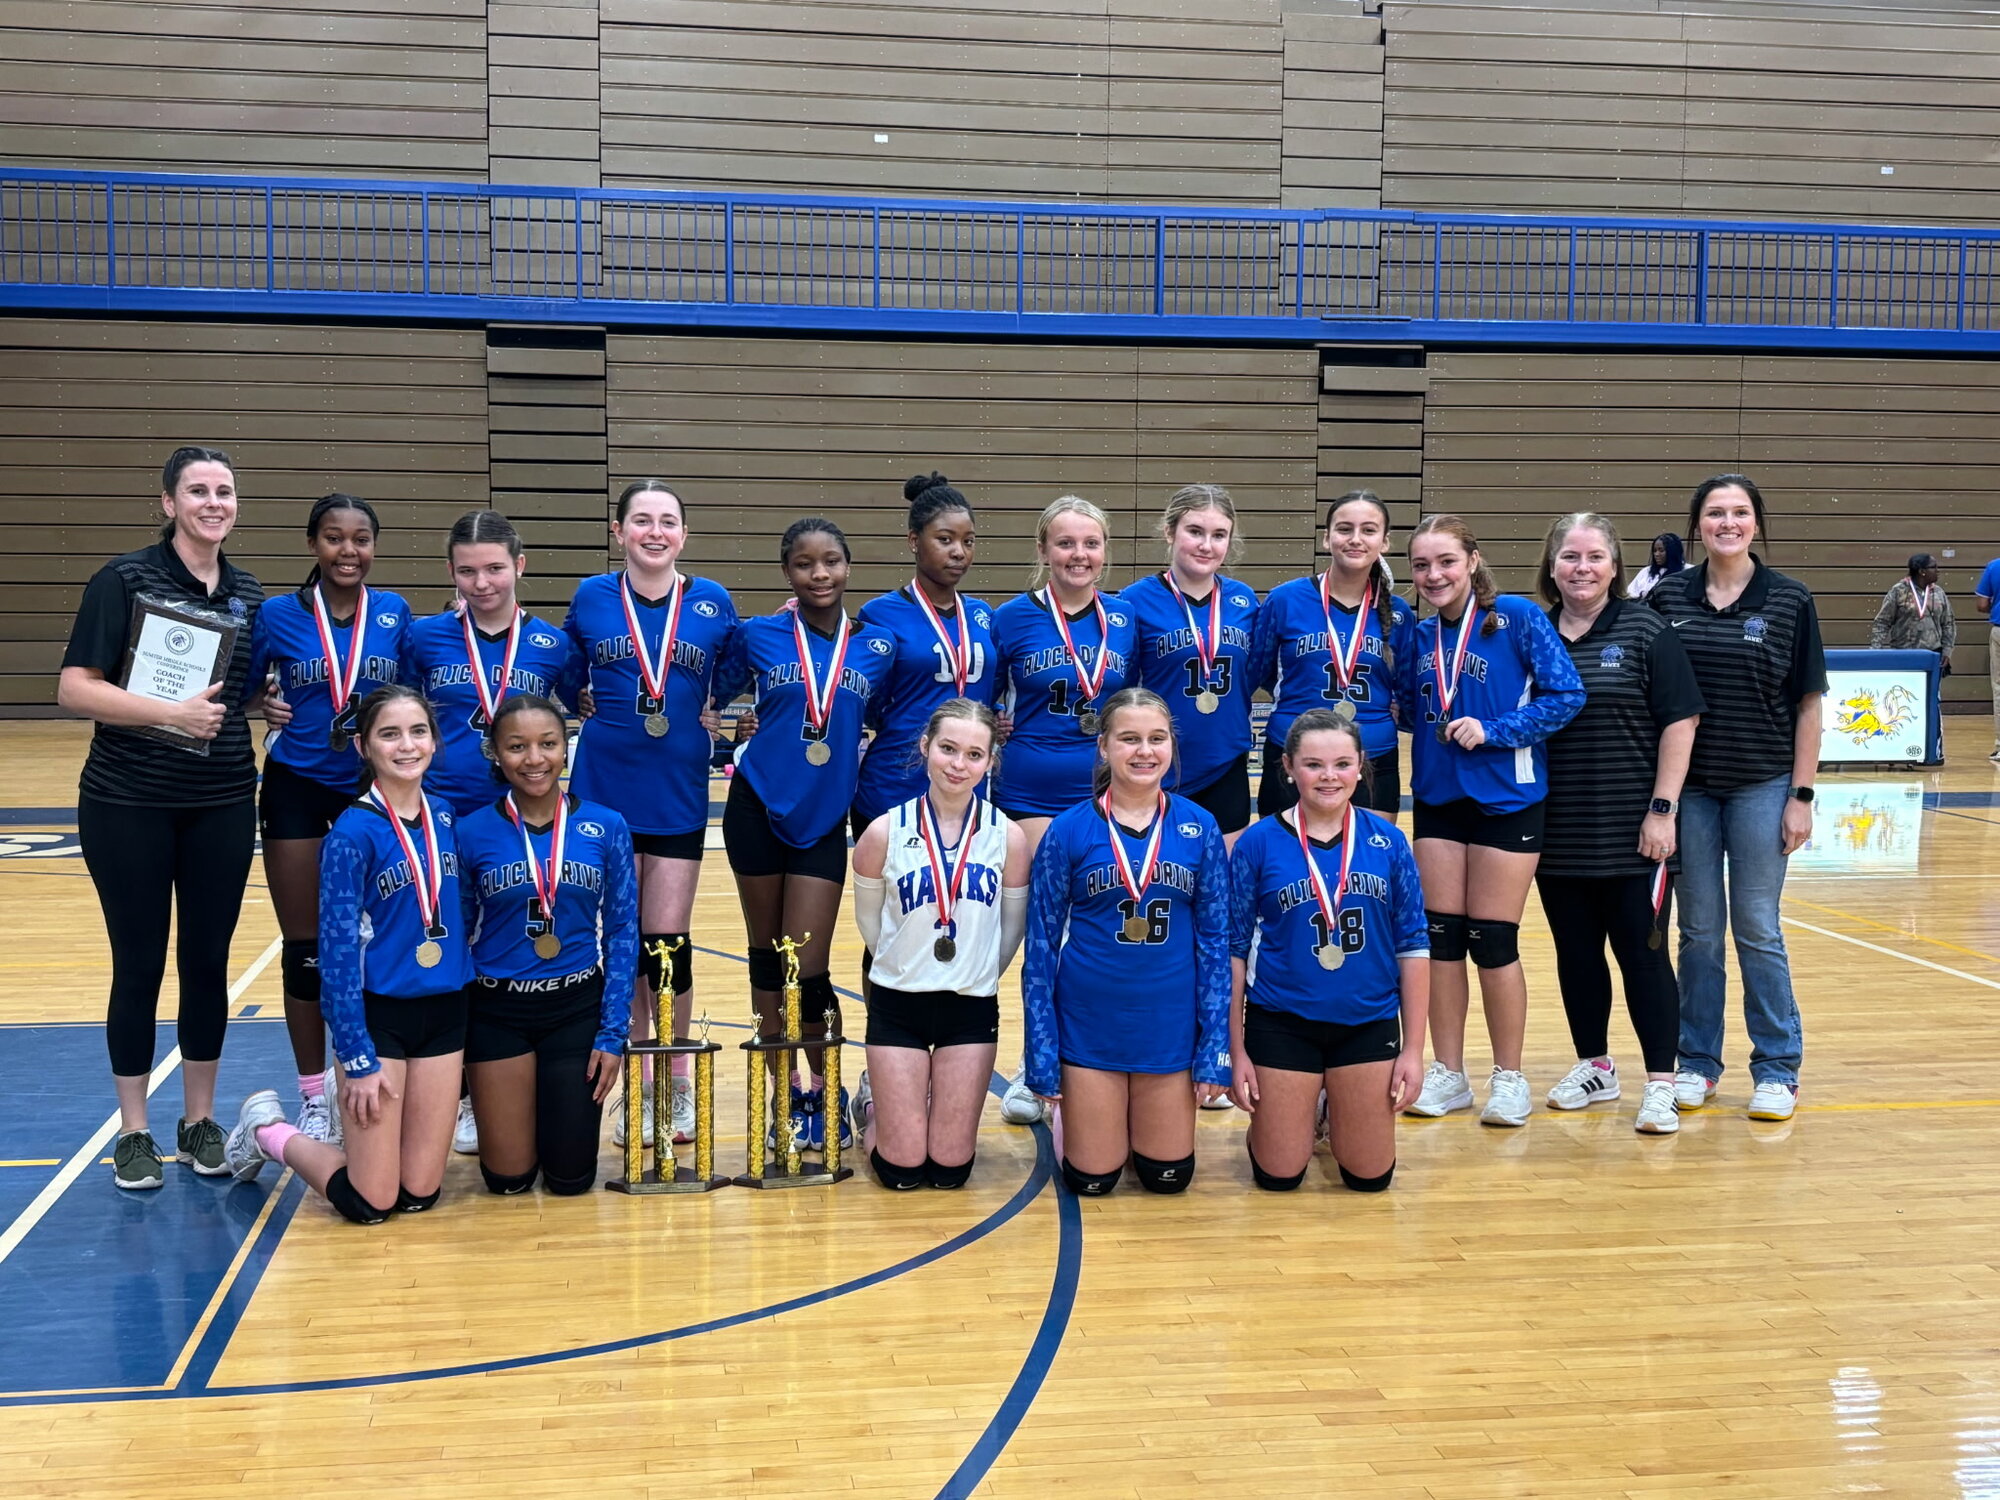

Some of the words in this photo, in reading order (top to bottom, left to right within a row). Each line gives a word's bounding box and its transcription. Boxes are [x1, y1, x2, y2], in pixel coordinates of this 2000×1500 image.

[699, 603, 714, 616] AD
[1111, 614, 1123, 625] AD
[534, 634, 551, 647] AD
[596, 634, 637, 666] ALIC
[873, 641, 888, 653] AD
[1156, 626, 1201, 659] ALIC
[155, 668, 186, 682] COACH
[290, 656, 331, 689] ALIC
[430, 663, 477, 692] ALIC
[932, 641, 985, 684] 10
[1079, 644, 1126, 679] DIVE
[1183, 655, 1233, 698] 13
[152, 676, 166, 684] OF
[166, 679, 185, 690] THE
[156, 684, 179, 696] YEAR
[1047, 678, 1104, 717] 12
[1321, 661, 1372, 704] 15
[331, 692, 363, 738] 2
[584, 822, 600, 836] AD
[1182, 825, 1198, 837] AD
[897, 861, 999, 916] HAKS
[525, 896, 556, 941] 5
[1115, 898, 1172, 945] 16
[1308, 906, 1366, 958] 18
[475, 975, 499, 988] RO
[507, 976, 562, 993] NIKE
[564, 966, 597, 988] PRO
